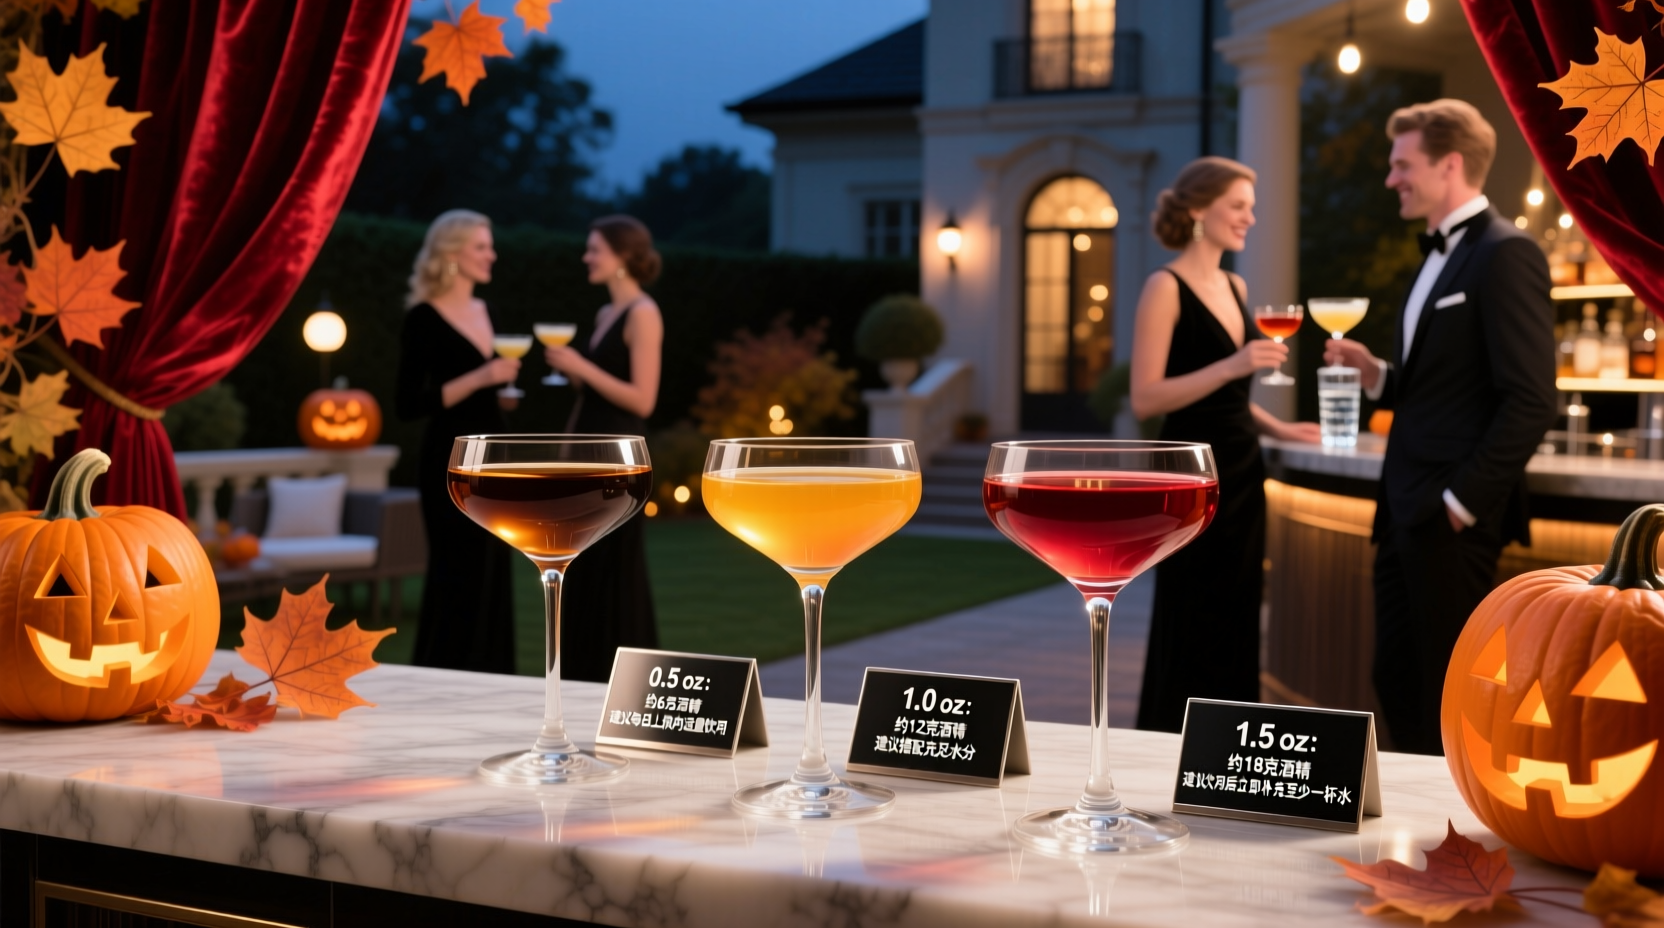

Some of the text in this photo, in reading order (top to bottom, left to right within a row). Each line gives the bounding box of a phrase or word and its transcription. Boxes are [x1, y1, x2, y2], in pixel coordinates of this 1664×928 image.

[648, 666, 711, 691] 0.5 oz:
[904, 686, 972, 715] 1.0 oz:
[1236, 720, 1318, 753] 1.5 oz:
[1227, 752, 1312, 780] 约18克酒精
